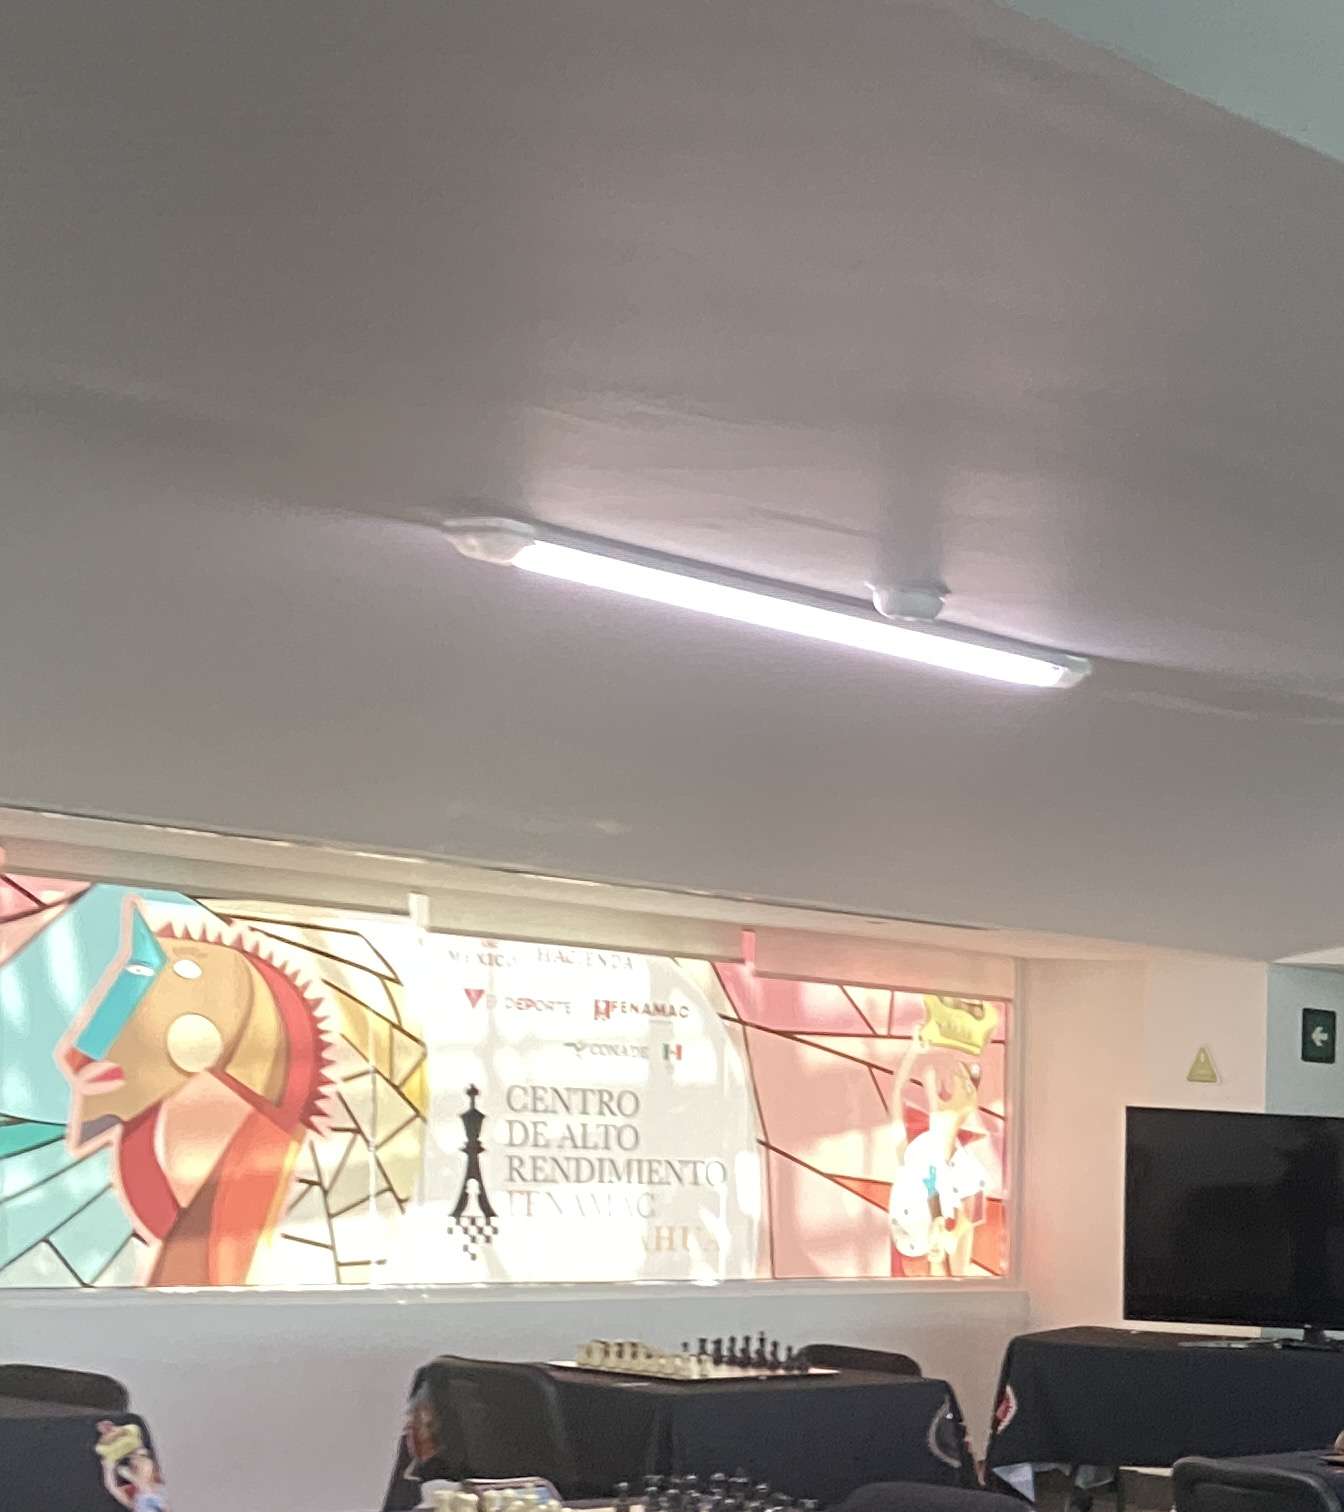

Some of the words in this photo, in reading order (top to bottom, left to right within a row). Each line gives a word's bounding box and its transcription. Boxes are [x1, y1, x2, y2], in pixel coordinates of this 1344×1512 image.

[611, 1000, 689, 1018] FENAMAC
[506, 1085, 640, 1117] CENTRO
[506, 1119, 550, 1148] DE
[557, 1123, 640, 1151] ALTO
[505, 1155, 727, 1186] RENDIMIENTO
